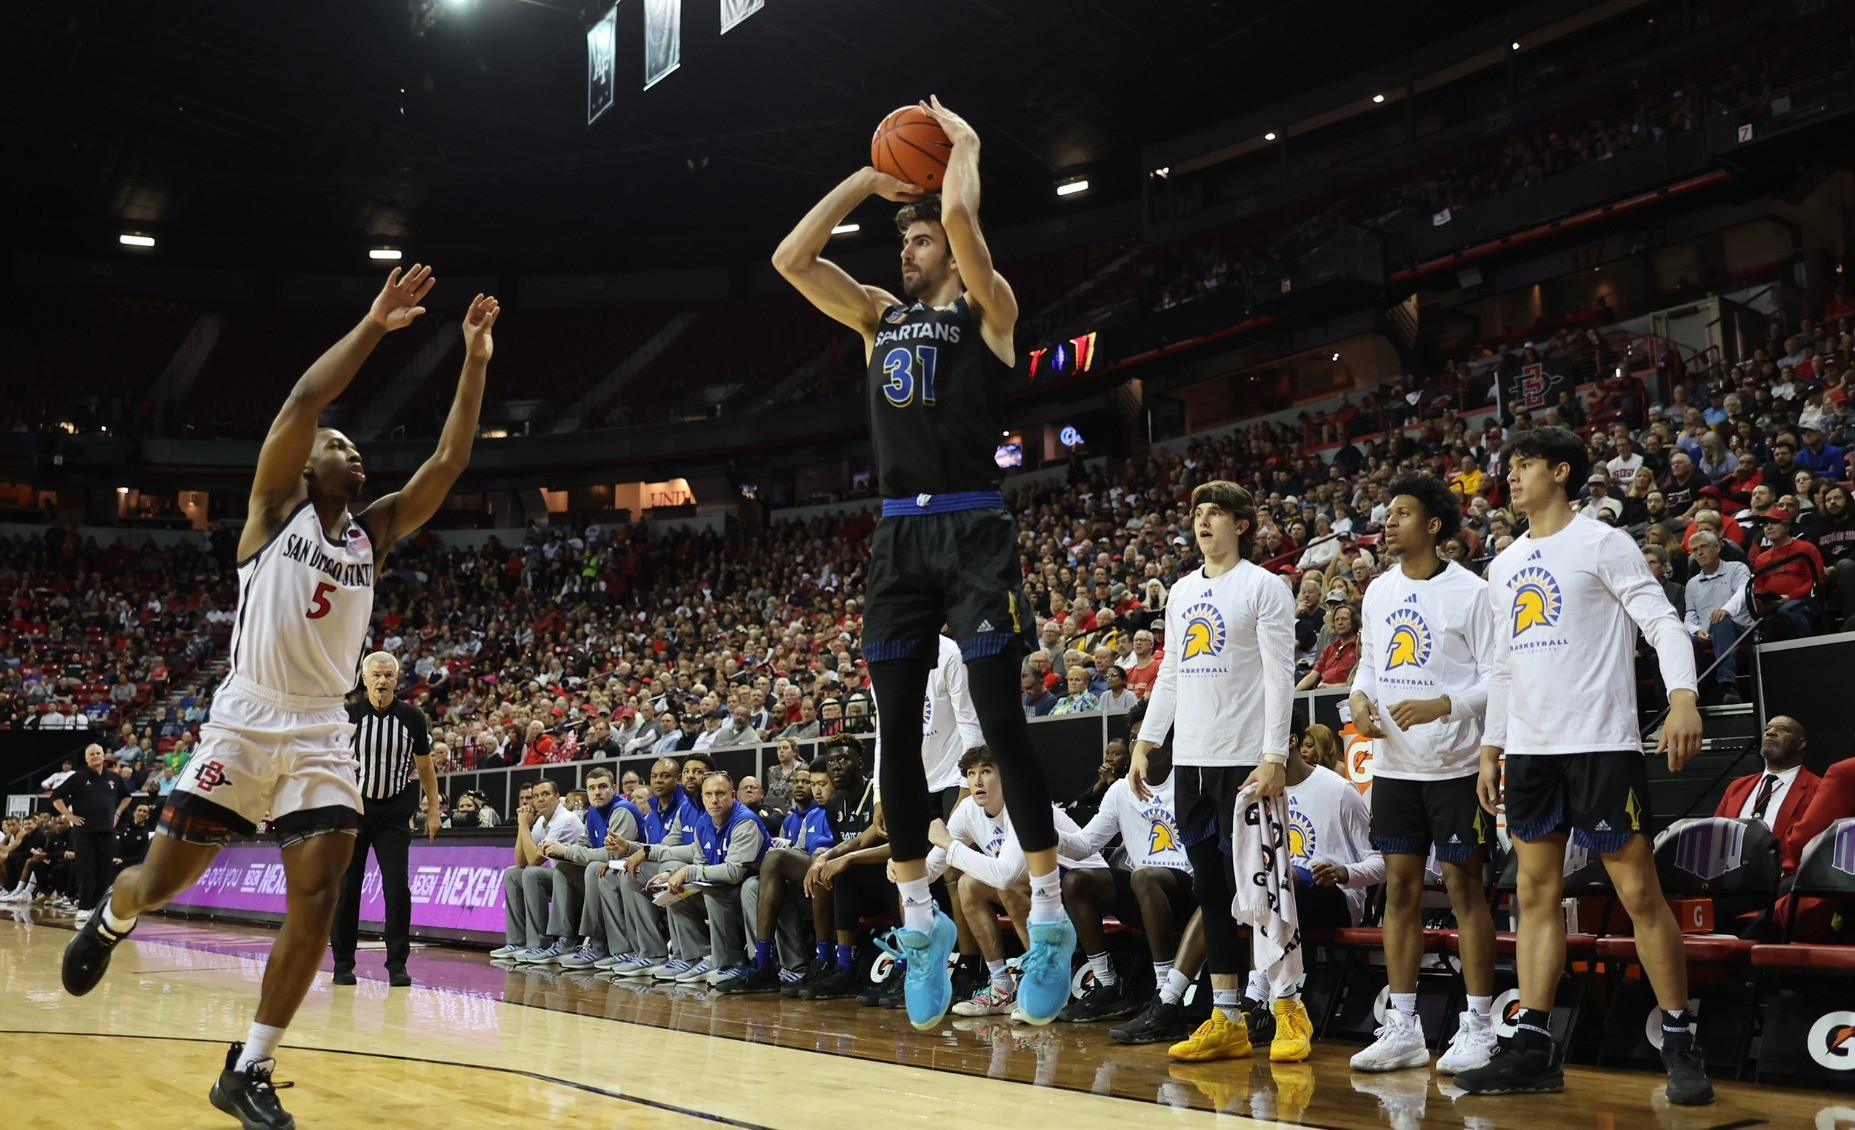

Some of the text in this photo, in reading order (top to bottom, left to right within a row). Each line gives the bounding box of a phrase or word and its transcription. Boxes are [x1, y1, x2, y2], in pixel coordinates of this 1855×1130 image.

[875, 322, 960, 347] SPARTANS
[883, 345, 937, 408] 31
[283, 533, 313, 564] SAN
[306, 581, 337, 619] 5
[1509, 638, 1569, 652] BASKETBALL
[1348, 740, 1373, 784] G
[434, 865, 506, 908] NEXEN
[1693, 905, 1704, 928] G
[1807, 1010, 1855, 1071] G
